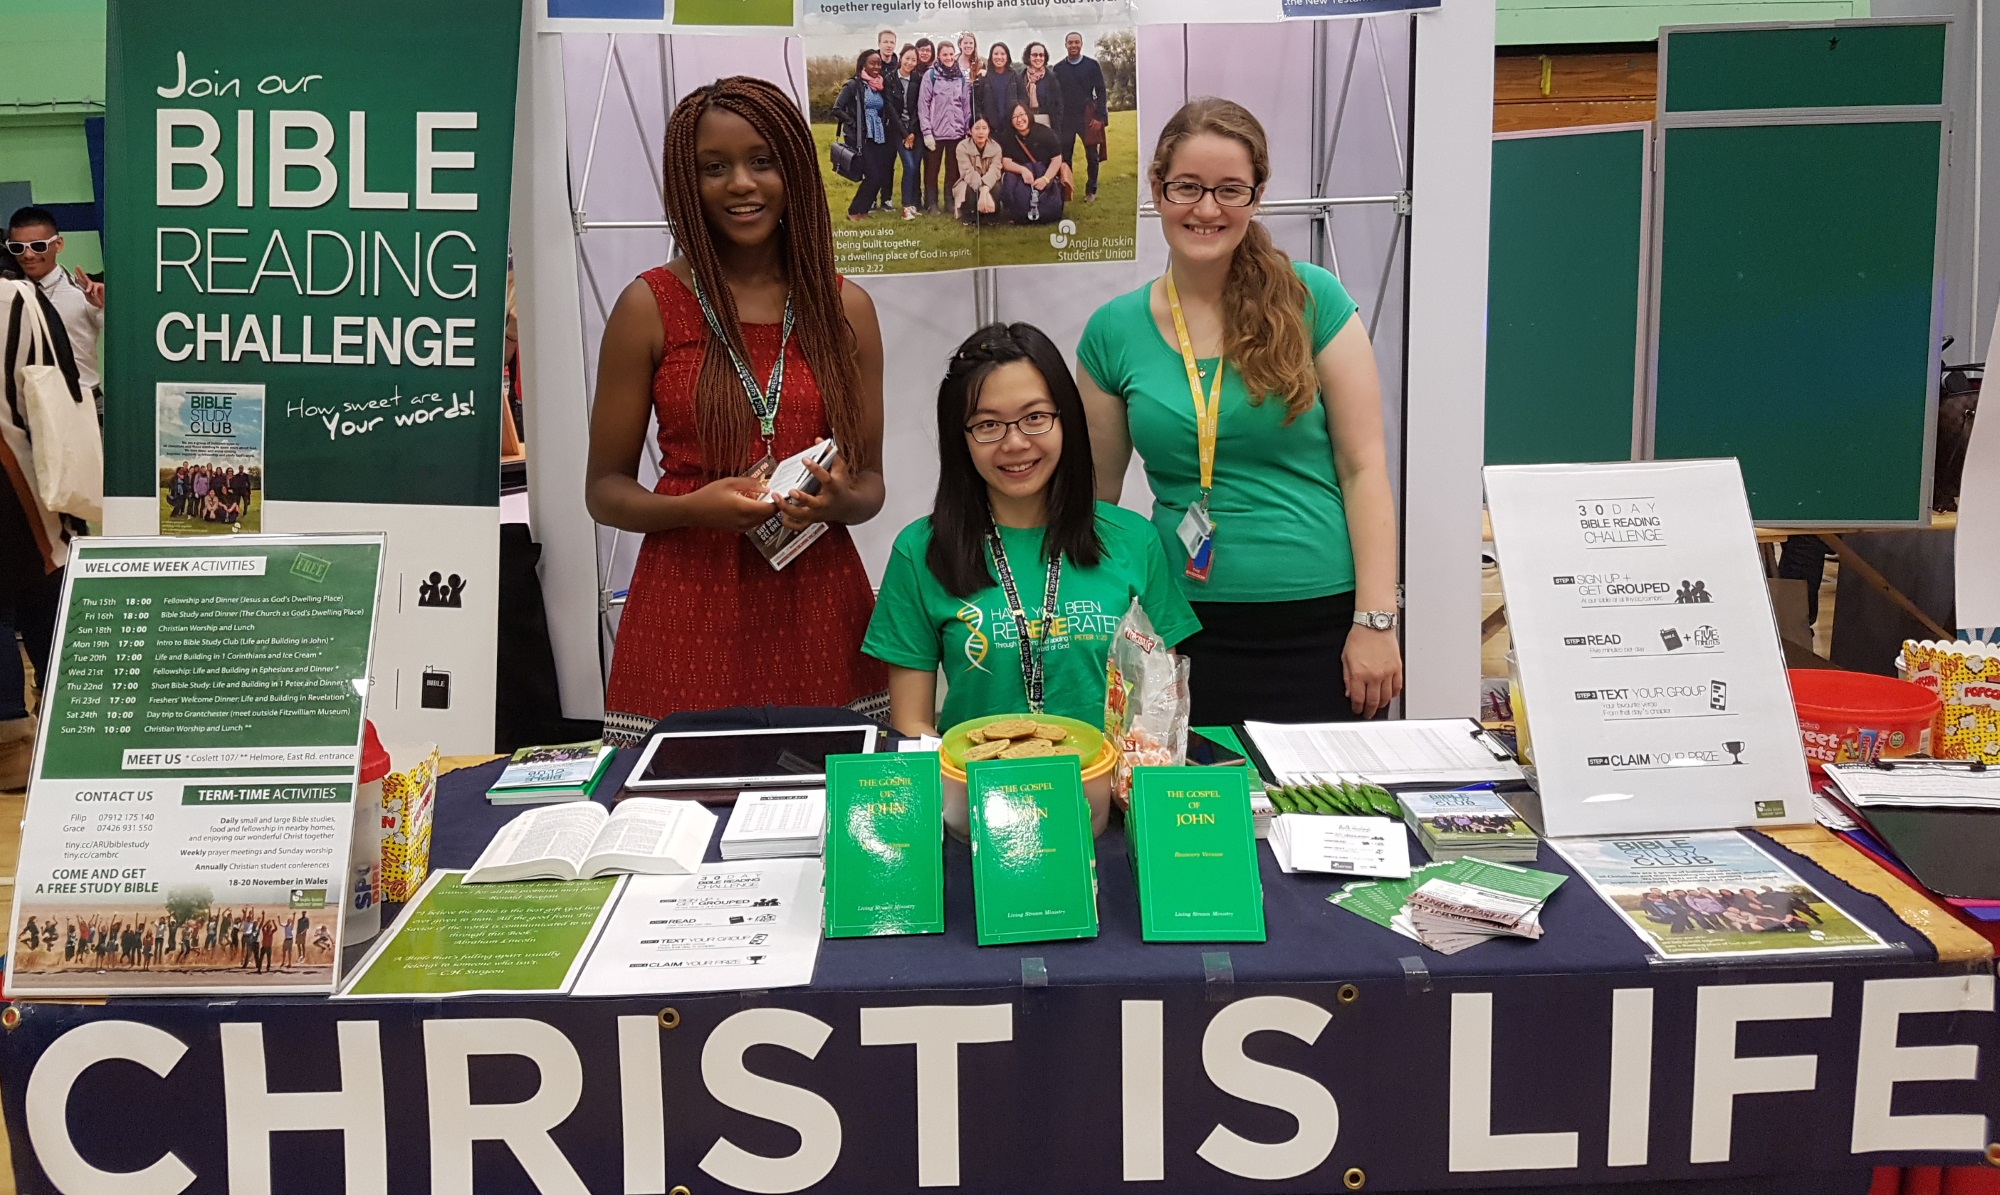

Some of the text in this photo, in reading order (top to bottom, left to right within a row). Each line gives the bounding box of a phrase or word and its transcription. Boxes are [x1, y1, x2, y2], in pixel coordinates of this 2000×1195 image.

[821, 2, 868, 14] together
[872, 0, 920, 12] regularly
[924, 1, 935, 9] to
[938, 0, 993, 10] fellowship
[157, 50, 323, 99] Join our
[156, 109, 477, 210] BIBLE
[877, 228, 894, 236] also
[837, 239, 920, 250] being built together
[1068, 236, 1133, 250] Anglia Ruskin
[848, 252, 883, 261] dwelling
[886, 252, 908, 261] place
[910, 251, 918, 259] of
[920, 250, 937, 258] God
[950, 249, 971, 258] spirit.
[1106, 249, 1132, 259] Union
[156, 228, 477, 299] READING
[156, 312, 475, 367] CHALLENGE
[191, 396, 232, 409] BIBLE
[287, 386, 442, 419] How sweet are
[191, 410, 232, 422] STUDY
[323, 390, 476, 441] Your words!
[191, 422, 232, 434] CLUB
[1580, 517, 1660, 529] BIBLE READING
[1584, 529, 1664, 543] CHALLENGE
[85, 560, 255, 573] WELCOME WEEK ACTIVITIES
[296, 557, 325, 578] FREE
[999, 560, 1013, 591] FRESHERS
[1049, 561, 1059, 592] FRESHERS
[1577, 574, 1620, 584] SIGN UP
[1579, 583, 1670, 595] GET GROUPED
[83, 598, 98, 606] Thu
[100, 598, 116, 606] 15th
[1009, 594, 1019, 609] 2016
[1065, 601, 1101, 615] BEEN
[95, 626, 111, 634] 18th
[189, 624, 217, 632] Worship
[93, 640, 109, 648] 19th
[1587, 634, 1621, 645] READ
[1022, 642, 1032, 677] FRESHERS
[426, 679, 445, 687] BIBLE
[1598, 686, 1706, 700] TEXT YOUR GROUP
[127, 754, 162, 765] MEET
[164, 754, 181, 764] US
[191, 754, 218, 762] Coslett
[250, 753, 284, 762] Helmore,
[1611, 754, 1650, 766] CLAIM
[1020, 782, 1054, 791] GOSPEL
[75, 791, 153, 801] CONTACT US
[198, 788, 336, 801] TERM-TIME ACTIVITIES
[1186, 790, 1221, 798] GOSPEL
[70, 814, 86, 822] Filip
[1176, 814, 1215, 827] JOHN
[66, 841, 149, 850] tiny.cc/ARUbiblestudy
[1613, 839, 1695, 851] BIBLE
[64, 851, 119, 860] tiny.cc/cambrc
[1624, 848, 1698, 858] STUDY
[1633, 856, 1714, 866] CLUB
[52, 868, 146, 879] COME AND GET
[35, 882, 159, 894] A FREE STUDY BIBLE
[26, 975, 1994, 1195] CHRIST IS LIFE
